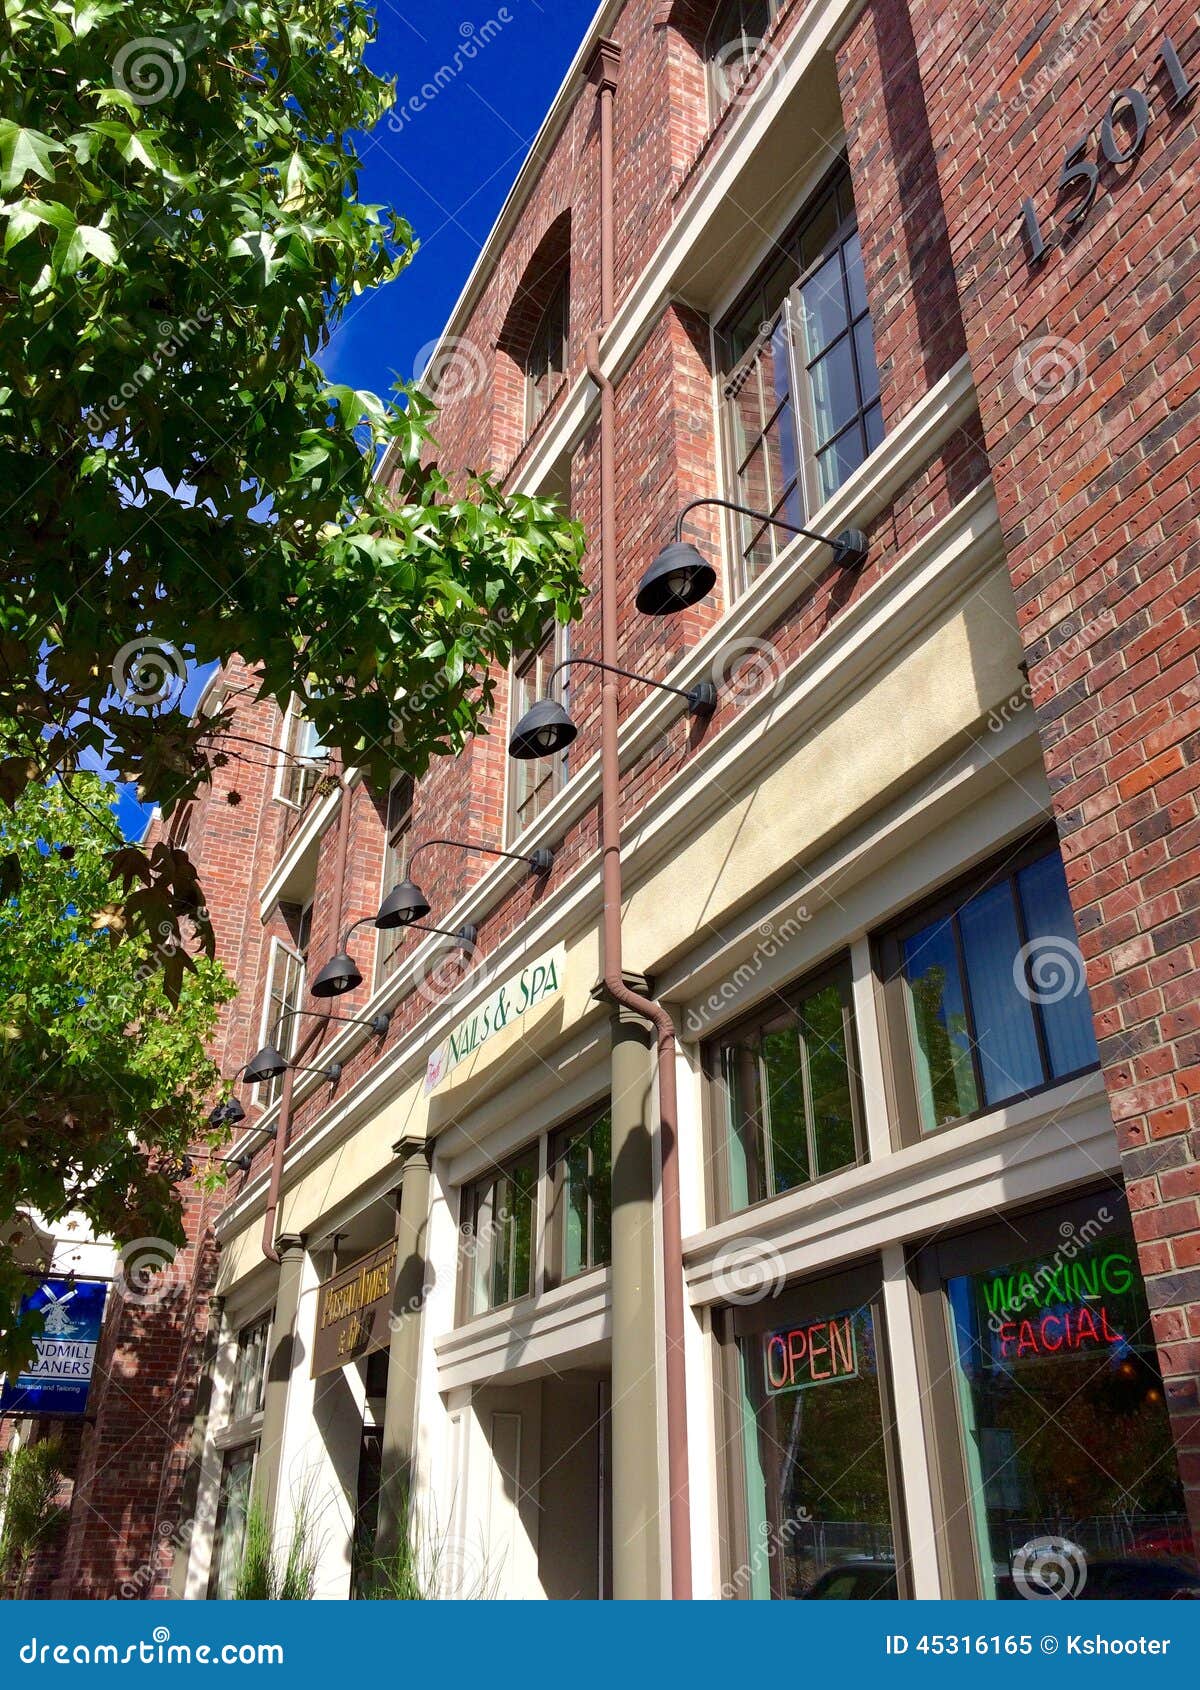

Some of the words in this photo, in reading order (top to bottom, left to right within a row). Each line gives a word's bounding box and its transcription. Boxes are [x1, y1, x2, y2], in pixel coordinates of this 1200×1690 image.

[1016, 34, 1199, 267] 1501
[449, 1005, 491, 1063] NAILS
[494, 987, 511, 1031] &
[516, 957, 558, 1015] SPA
[983, 1253, 1133, 1314] WAXING
[34, 1344, 92, 1359] NDMILL
[767, 1317, 854, 1389] OPEN
[1000, 1307, 1124, 1357] FACIAL
[31, 1361, 90, 1375] EANERS
